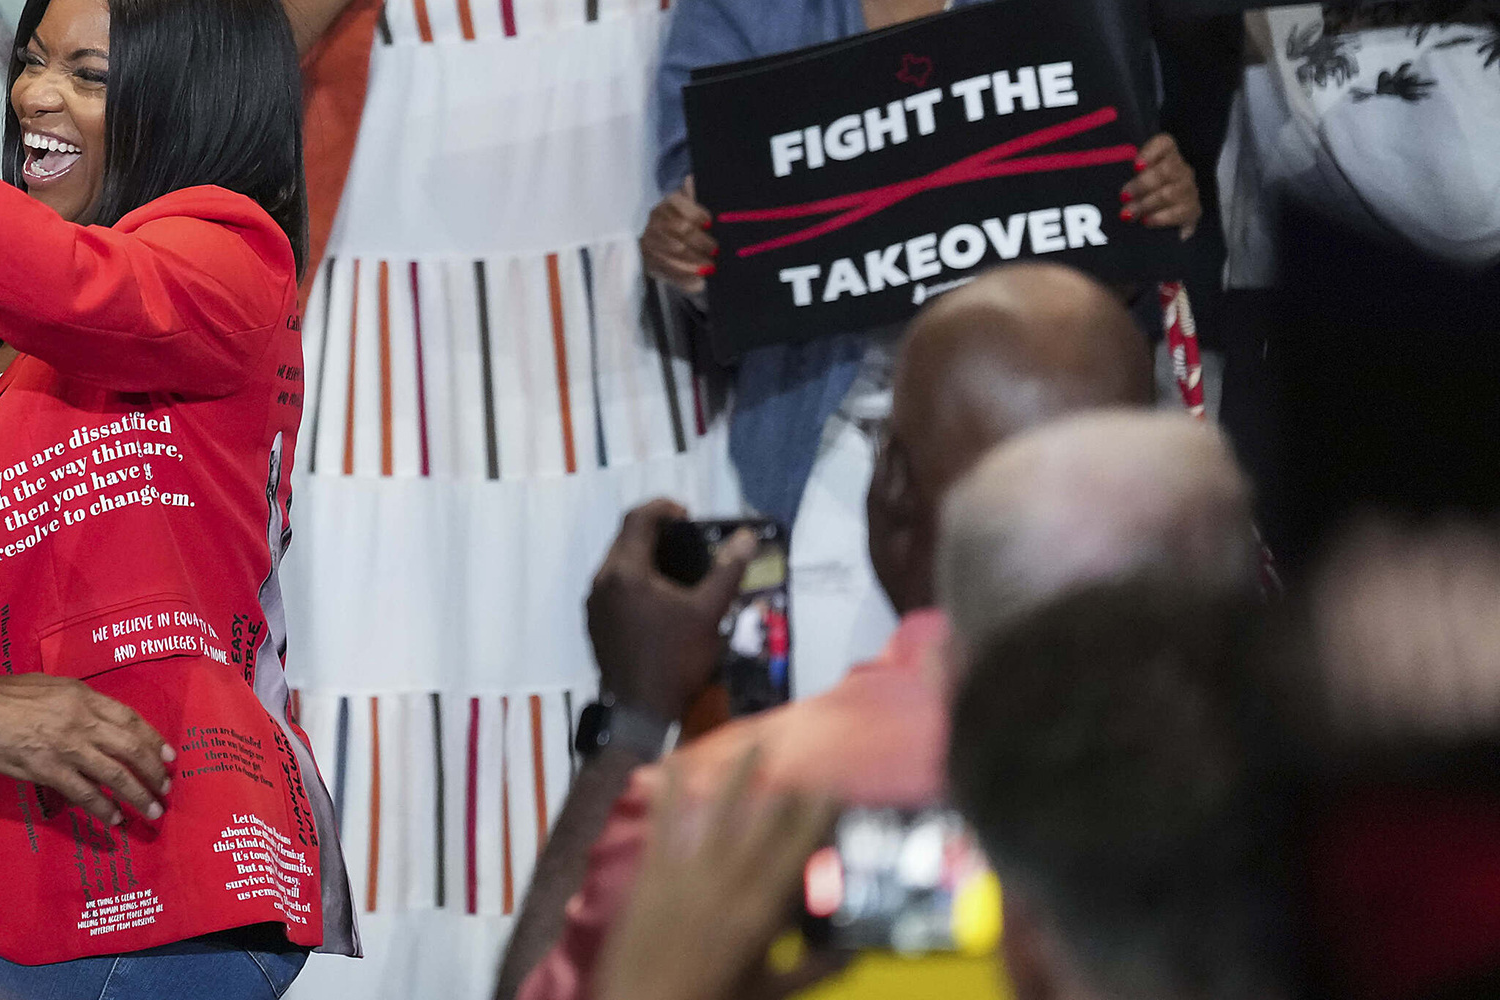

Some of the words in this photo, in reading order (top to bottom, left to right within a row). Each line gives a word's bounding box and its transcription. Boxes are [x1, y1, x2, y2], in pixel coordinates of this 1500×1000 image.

[769, 88, 944, 178] FIGHT
[951, 60, 1079, 123] THE
[778, 203, 1109, 308] TAKEOVER
[31, 441, 66, 468] are
[12, 477, 47, 502] the
[50, 456, 88, 483] way
[143, 441, 184, 462] are,
[3, 498, 50, 532] then
[53, 482, 89, 512] you
[90, 462, 141, 491] have
[63, 507, 86, 526] to
[89, 484, 159, 517] change
[160, 491, 196, 508] em.
[92, 625, 109, 644] WE
[112, 614, 154, 638] BELIEVE
[156, 611, 170, 628] IN
[231, 613, 249, 665] EASY,
[114, 644, 137, 663] AND
[140, 635, 198, 655] PRIVILEGES
[243, 620, 263, 687] SIBLE.
[221, 826, 250, 838] about
[232, 813, 249, 824] Let
[213, 840, 235, 853] this
[236, 838, 259, 849] kind
[232, 851, 249, 863] It's
[225, 875, 266, 891] survive
[236, 863, 257, 875] But
[237, 891, 251, 901] us
